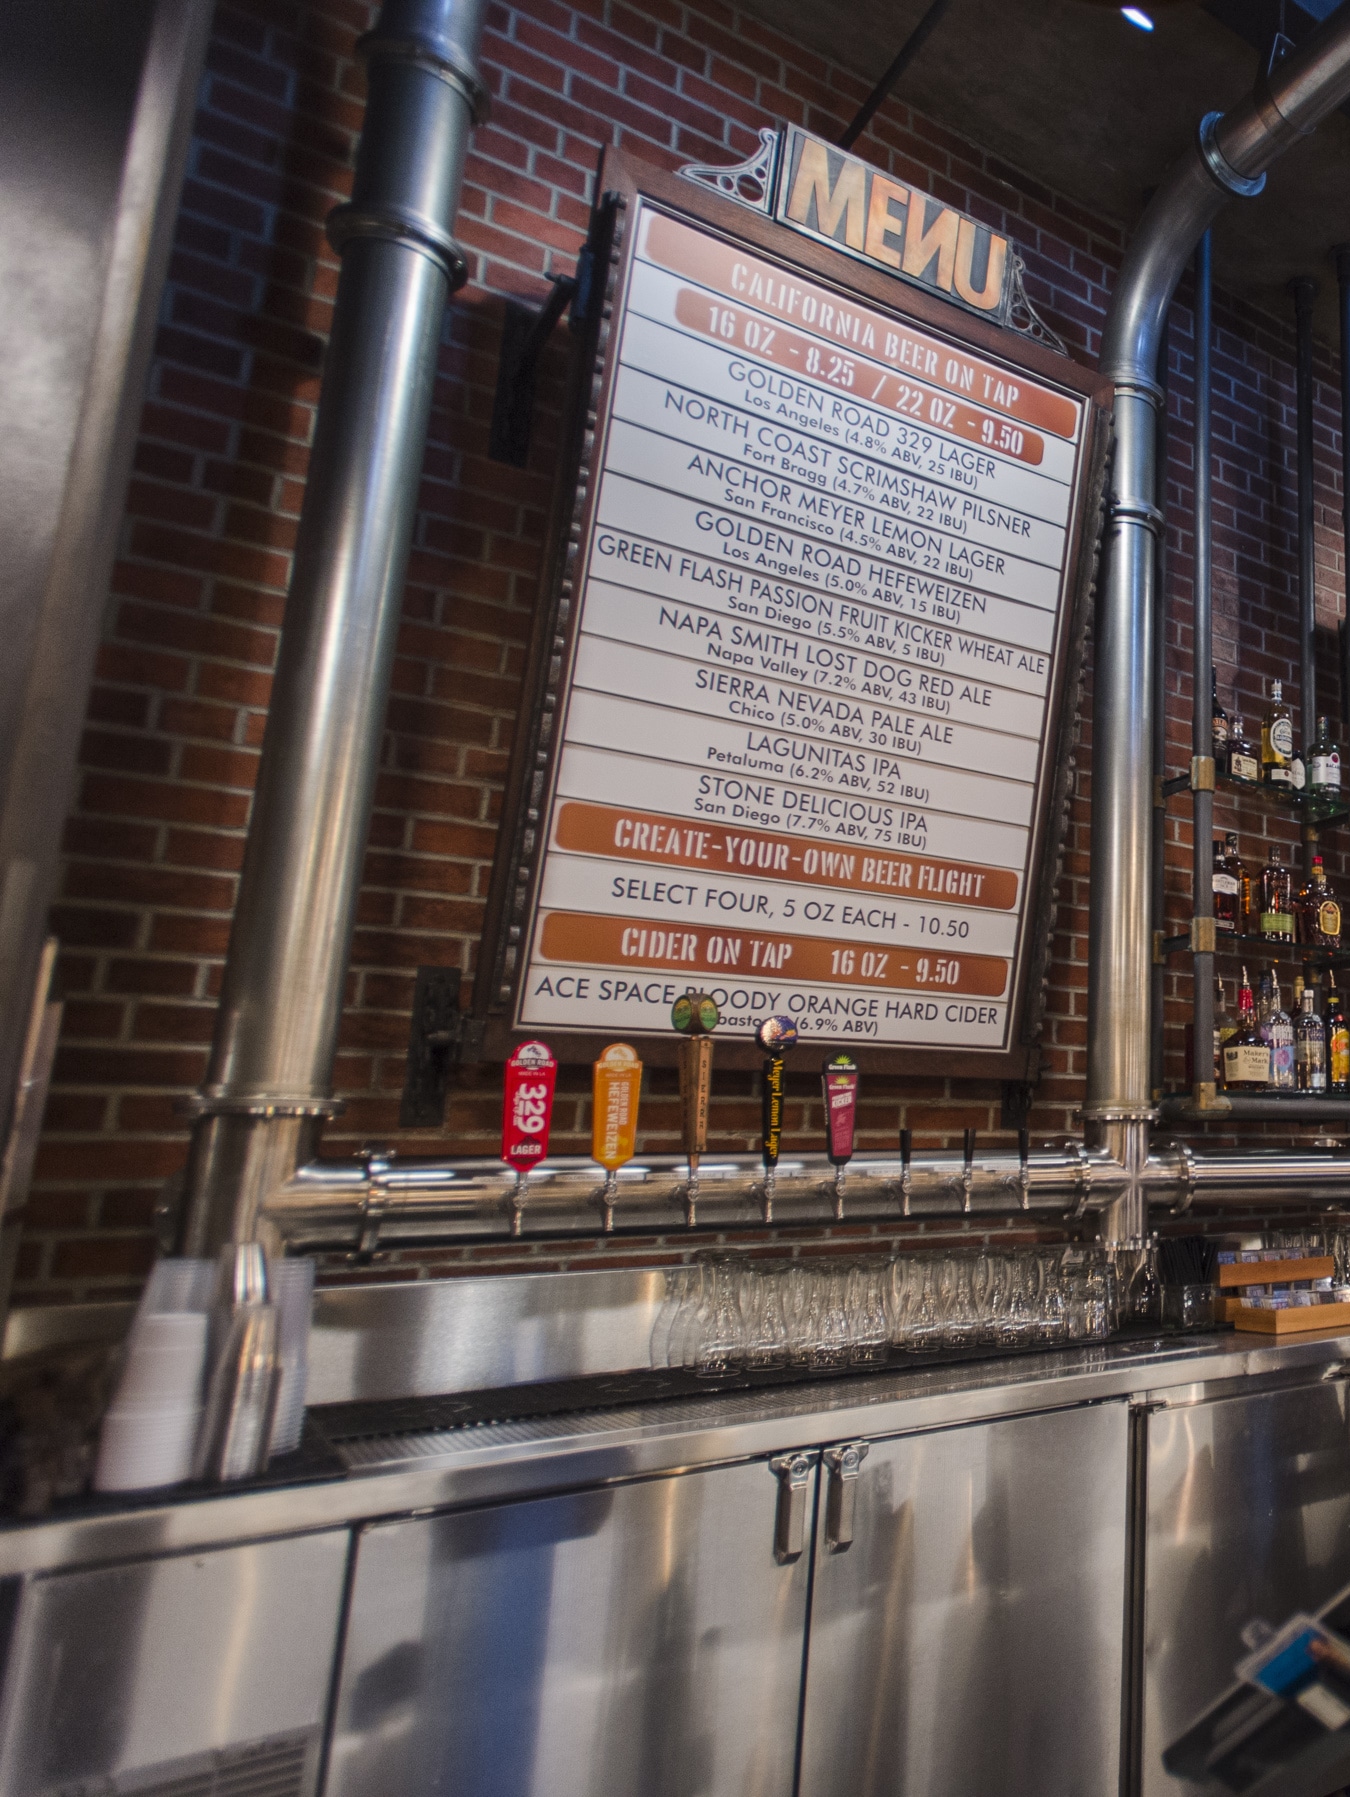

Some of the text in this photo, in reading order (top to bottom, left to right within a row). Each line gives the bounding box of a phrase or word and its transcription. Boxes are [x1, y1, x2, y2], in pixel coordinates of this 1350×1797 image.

[730, 261, 1018, 407] CALIFORNIA BEER ON TAP
[708, 305, 1023, 454] 16 OZ 8.25 22 OZ 9.50
[728, 360, 996, 479] GOLDEN ROAD 329 LAGER
[664, 389, 1031, 538] NORTH COAST SCRIMSHAW PILSNER
[744, 389, 978, 491] Los Angeles (4.8% ABV, 25 IBU)
[686, 454, 1005, 575] ANCHOR MEYER LEMON LAGER
[695, 510, 986, 613] GOLDEN ROAD HEFEWEIZEN
[597, 534, 1045, 675] GREEN FLASH PASSION FRUIT KICKER WHEAT ALE
[746, 731, 901, 780] LAGUNITAS IPA
[698, 774, 928, 832] STONE DELICIOUS IPA
[614, 818, 985, 898] CREATE-YOUR-OWN BEER FLIGHT
[611, 876, 969, 938] SELECT FOUR, 5 OZ EACH 10.50
[620, 927, 960, 985] CIDER ON TAP 16 OZ 9.50
[534, 976, 590, 999] ACE
[598, 979, 676, 1008] SPACE
[787, 993, 878, 1017] ORANGE
[885, 1000, 938, 1021] HARD
[944, 1004, 998, 1025] CIDER
[842, 1019, 878, 1036] ABV)
[518, 1083, 547, 1133] 329
[605, 1082, 620, 1159] HEFEWEIZEN
[765, 1059, 784, 1158] Meyer Lemon Lager
[510, 1146, 541, 1155] LAGER
